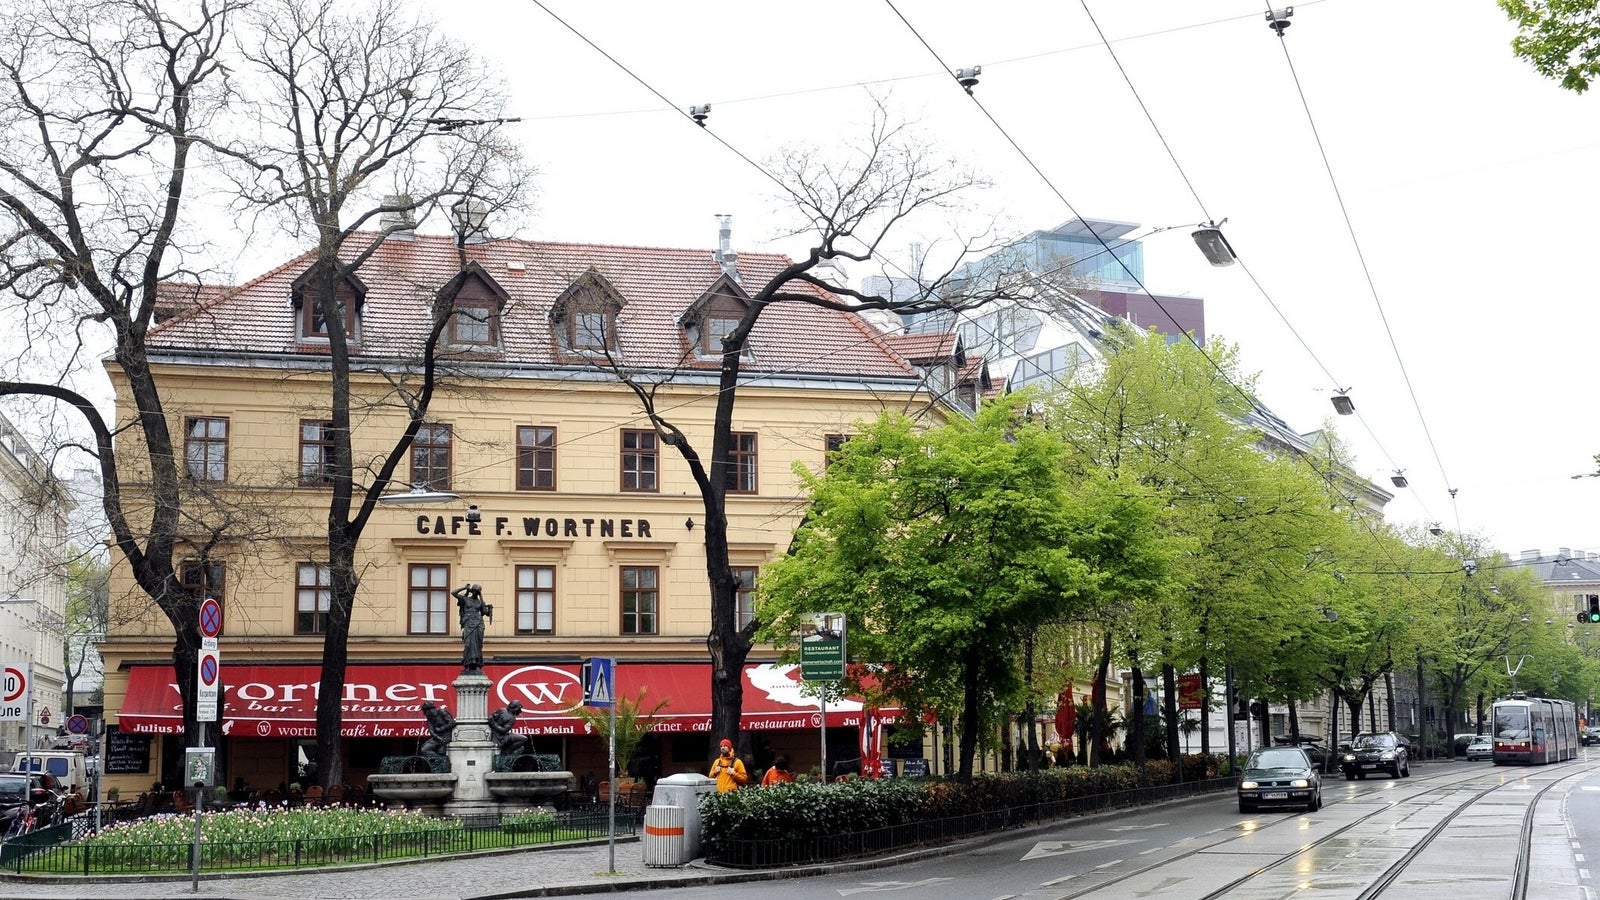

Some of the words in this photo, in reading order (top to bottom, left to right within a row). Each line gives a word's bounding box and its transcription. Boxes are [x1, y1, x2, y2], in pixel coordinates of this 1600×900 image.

[495, 517, 513, 536] F.
[522, 517, 652, 538] WORTNER
[692, 719, 712, 731] caf
[749, 717, 806, 730] restaurant
[843, 717, 860, 726] Jul
[133, 723, 173, 733] Julius
[278, 727, 317, 736] wortn
[509, 726, 540, 735] ulius
[543, 726, 574, 734] Meinl
